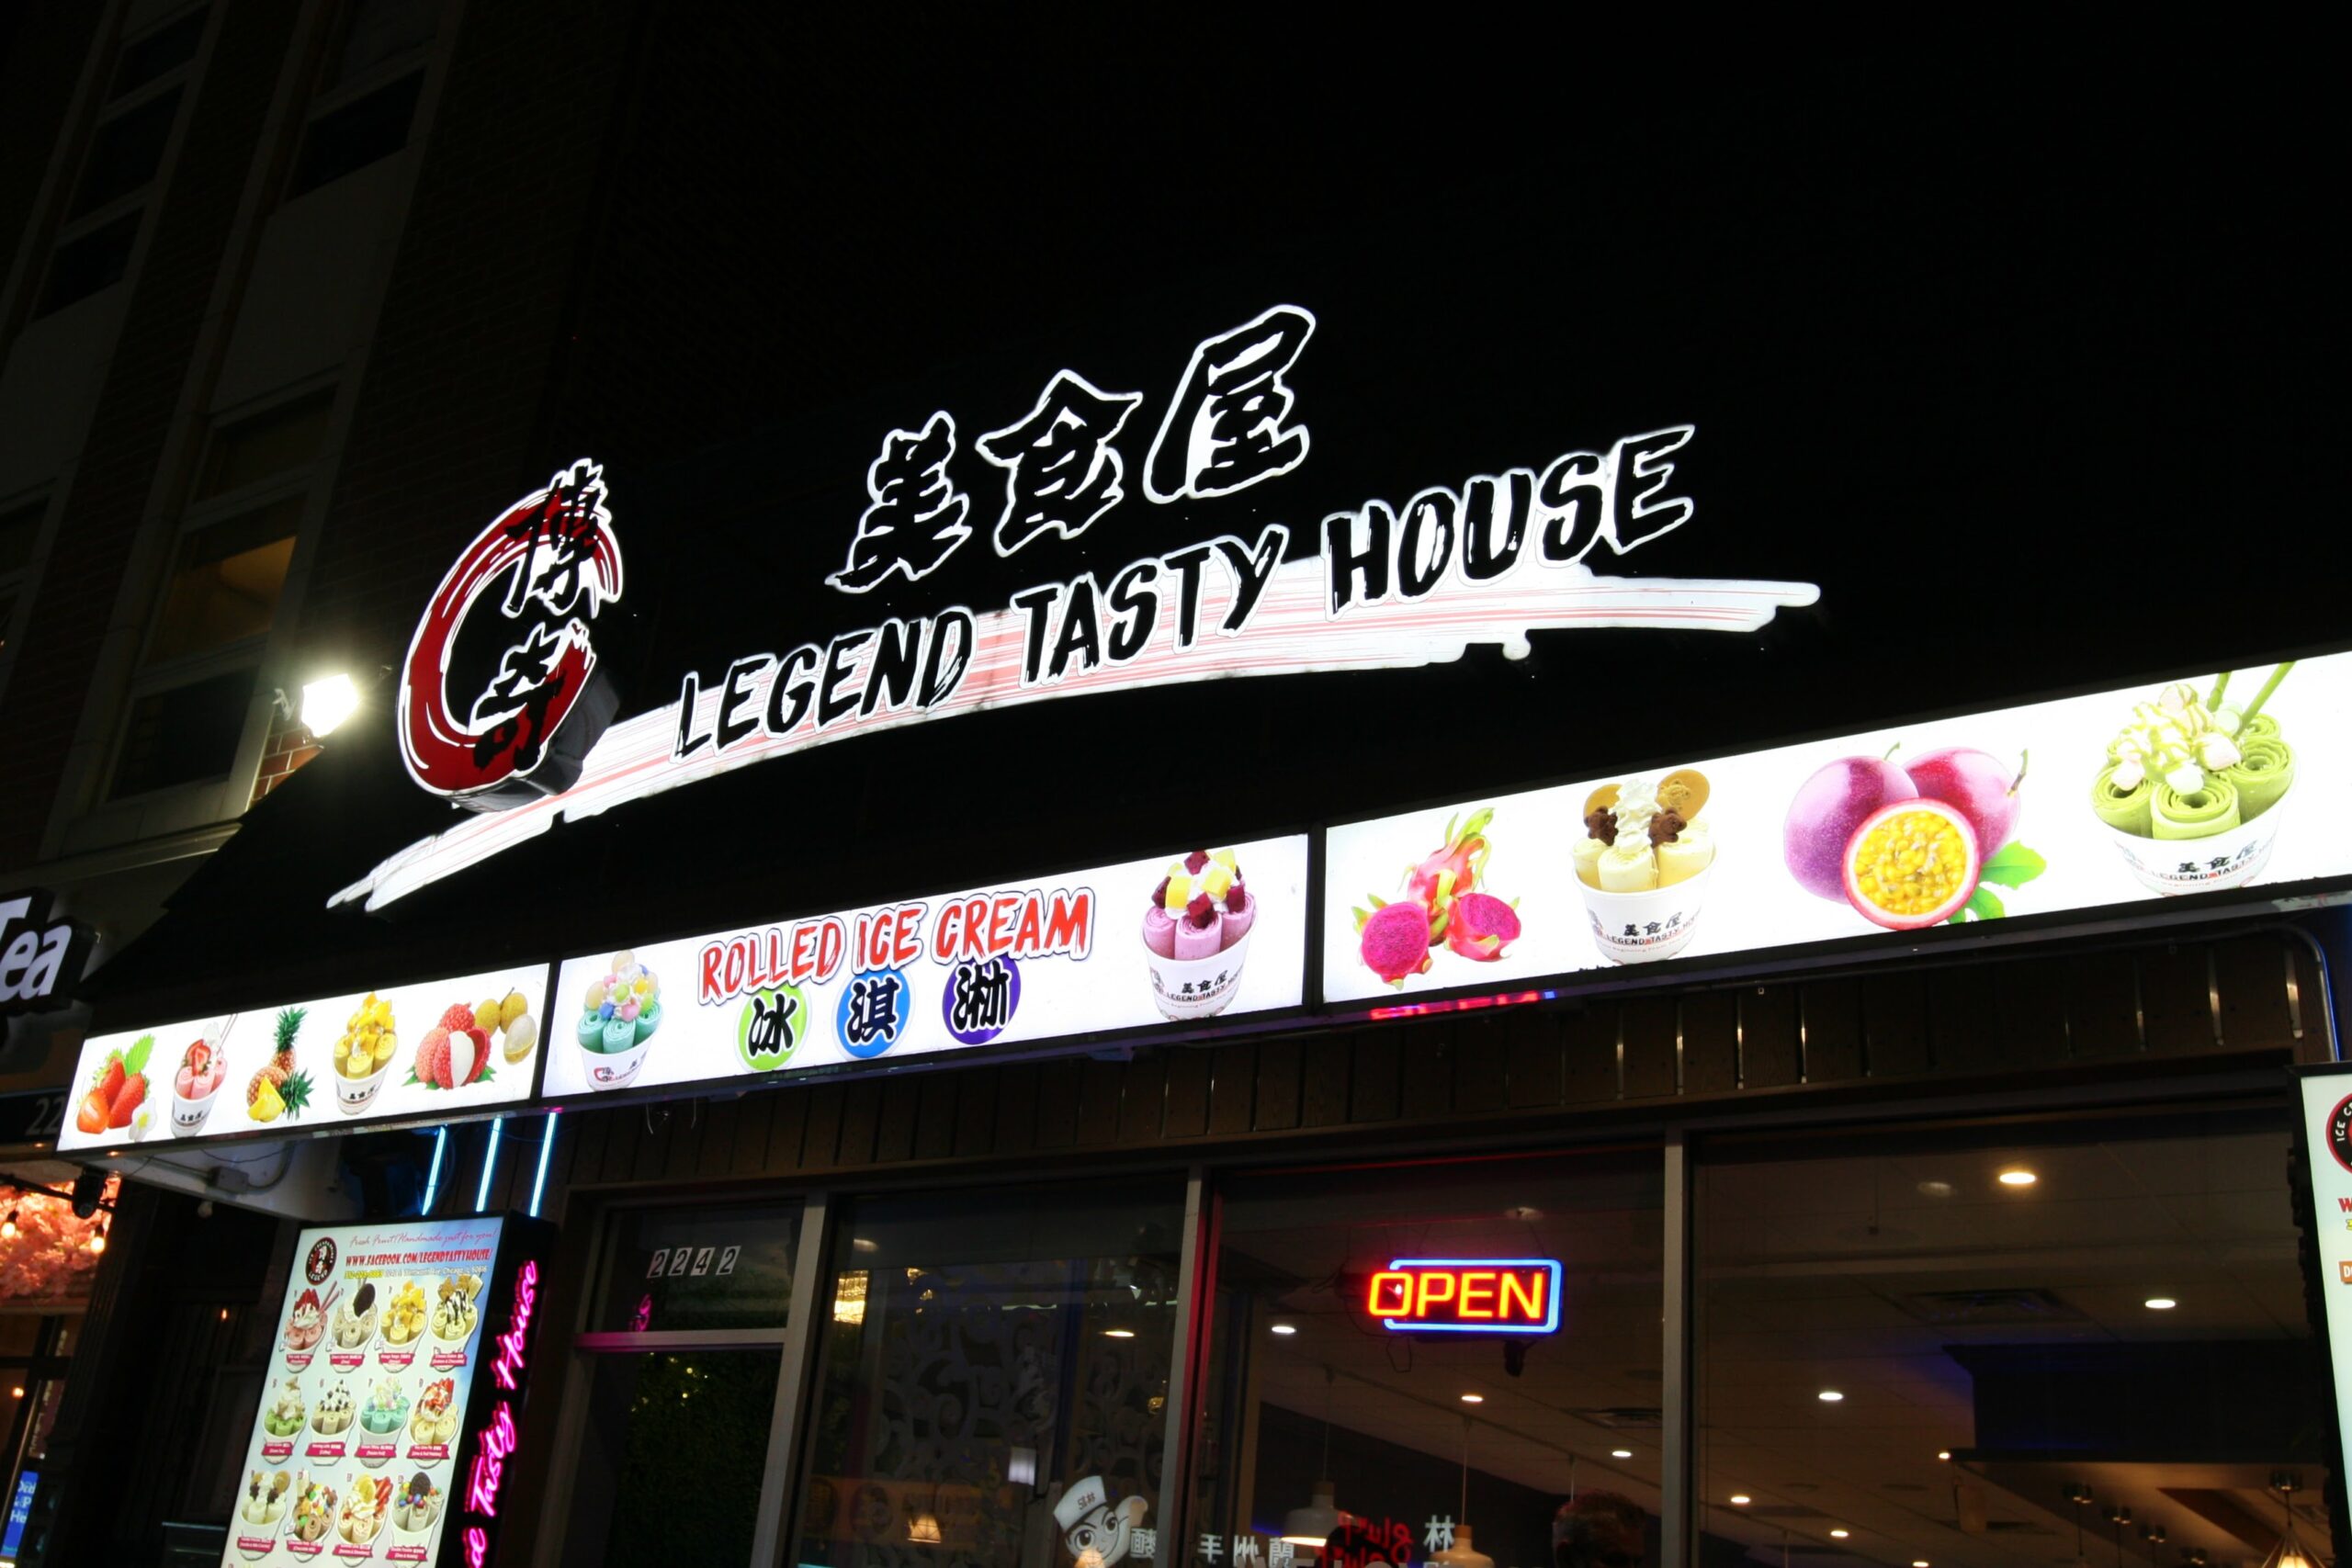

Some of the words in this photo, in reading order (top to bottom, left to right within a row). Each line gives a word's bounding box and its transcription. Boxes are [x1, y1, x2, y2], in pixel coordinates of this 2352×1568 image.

[826, 305, 1317, 595] 美食屋
[673, 610, 974, 761] LEGEND
[1012, 527, 1287, 687] TASTY
[1322, 424, 1695, 617] HOUSE
[701, 921, 843, 1000] ROLLED
[856, 908, 922, 967] ICE
[935, 894, 1091, 961] CREAM
[1606, 932, 1645, 946] LEGEND
[1650, 928, 1680, 943] TASTY
[1166, 991, 1200, 1003] LEGEND
[1201, 984, 1226, 999] TASTY
[1182, 970, 1228, 995] 美食屋
[748, 960, 1011, 1056] 冰淇淋
[2335, 1120, 2346, 1143] ICE
[649, 1248, 738, 1277] 2242
[1369, 1272, 1544, 1319] OPEN
[467, 1401, 517, 1518] Tasty
[493, 1259, 539, 1391] House
